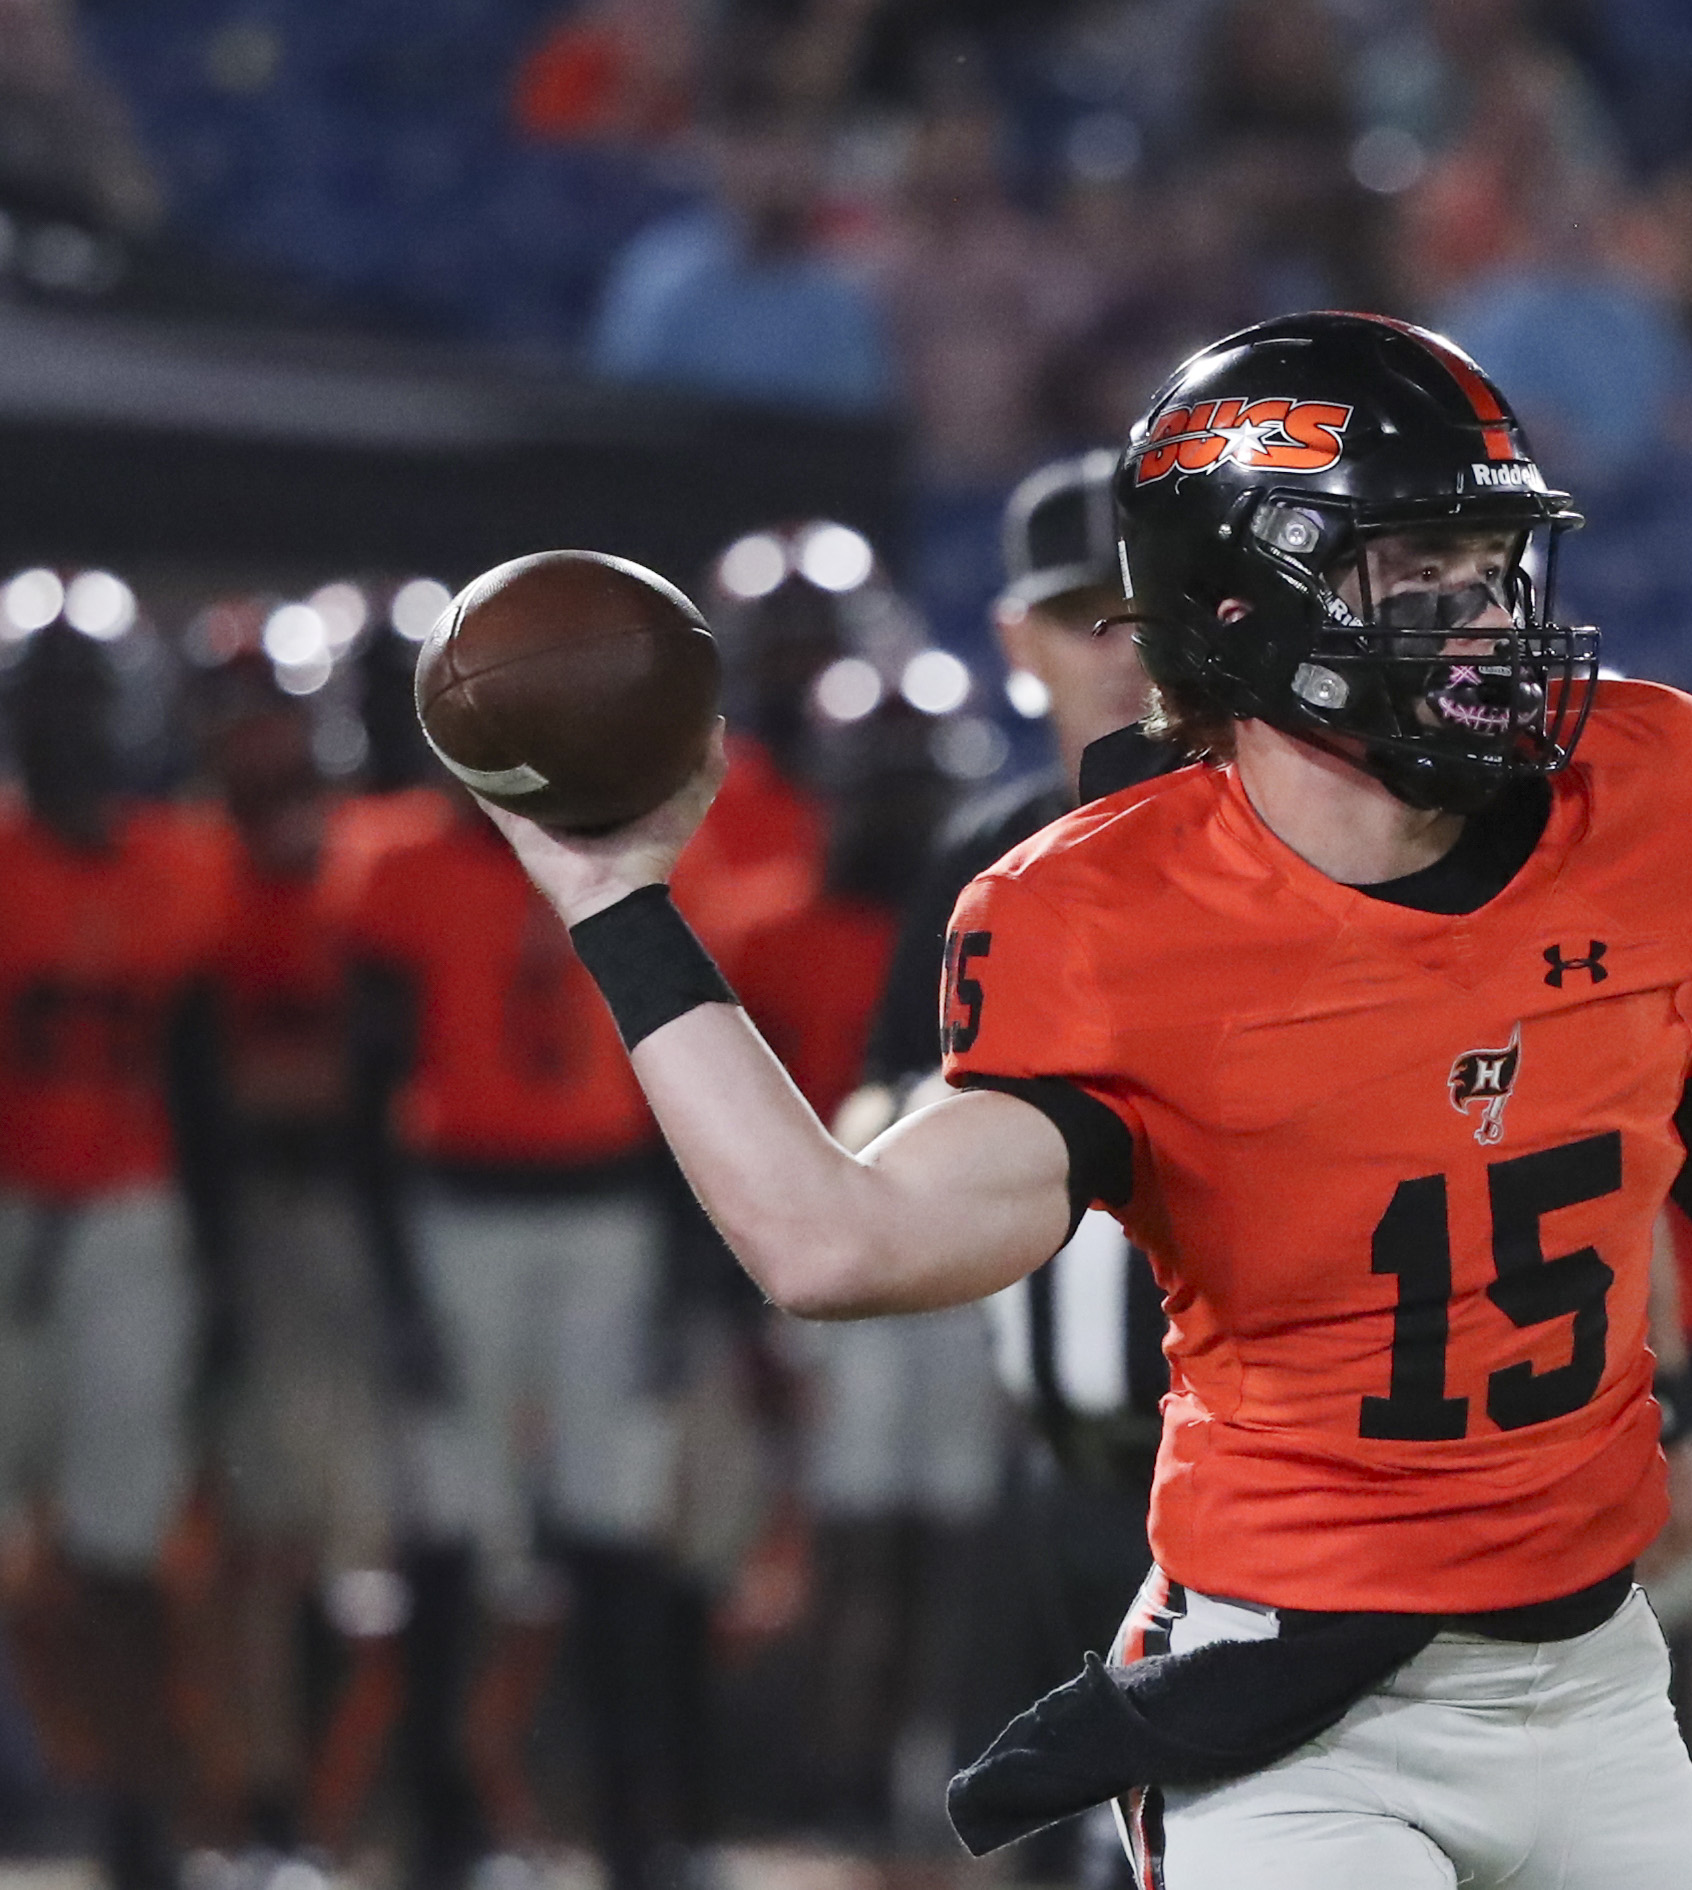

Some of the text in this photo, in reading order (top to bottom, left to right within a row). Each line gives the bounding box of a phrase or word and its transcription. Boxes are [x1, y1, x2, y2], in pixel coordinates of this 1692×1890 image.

[1135, 397, 1355, 488] BUCS
[1471, 1056, 1508, 1092] H
[1359, 1129, 1622, 1441] 15
